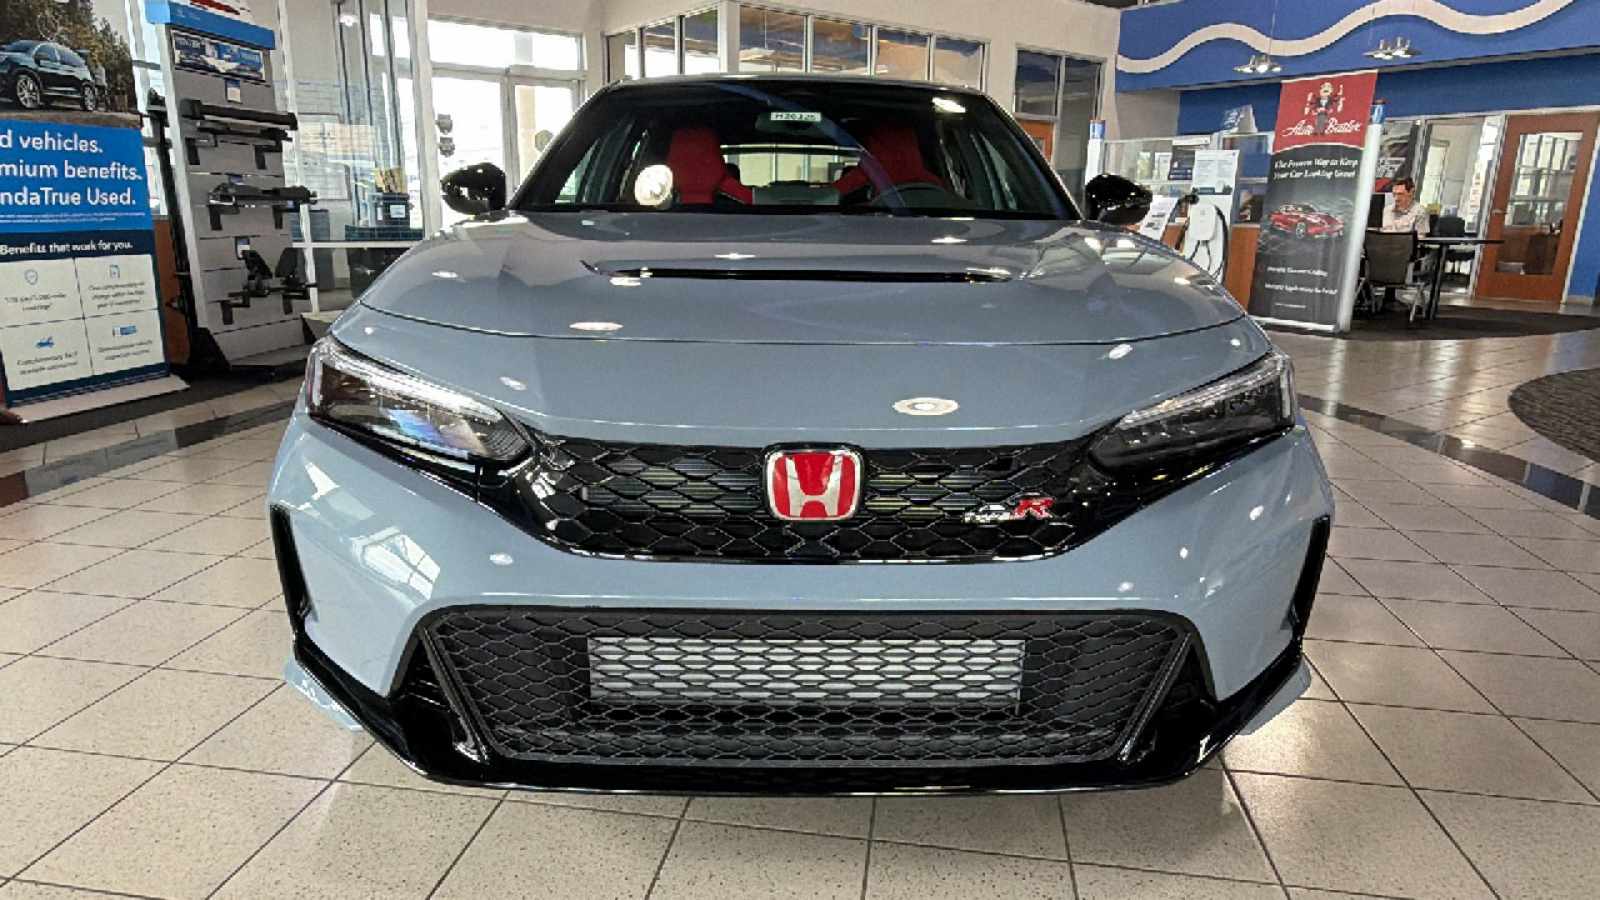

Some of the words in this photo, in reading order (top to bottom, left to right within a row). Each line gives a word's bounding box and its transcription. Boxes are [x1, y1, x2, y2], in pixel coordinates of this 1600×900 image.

[1281, 119, 1315, 136] Auto
[1325, 117, 1363, 134] Butler
[20, 130, 103, 153] vehicles.
[64, 160, 143, 180] benefits.
[87, 187, 136, 205] Used.
[0, 242, 46, 255] Benefits
[49, 242, 71, 254] that
[72, 240, 97, 251] work
[99, 240, 111, 251] for
[111, 241, 133, 252] you.
